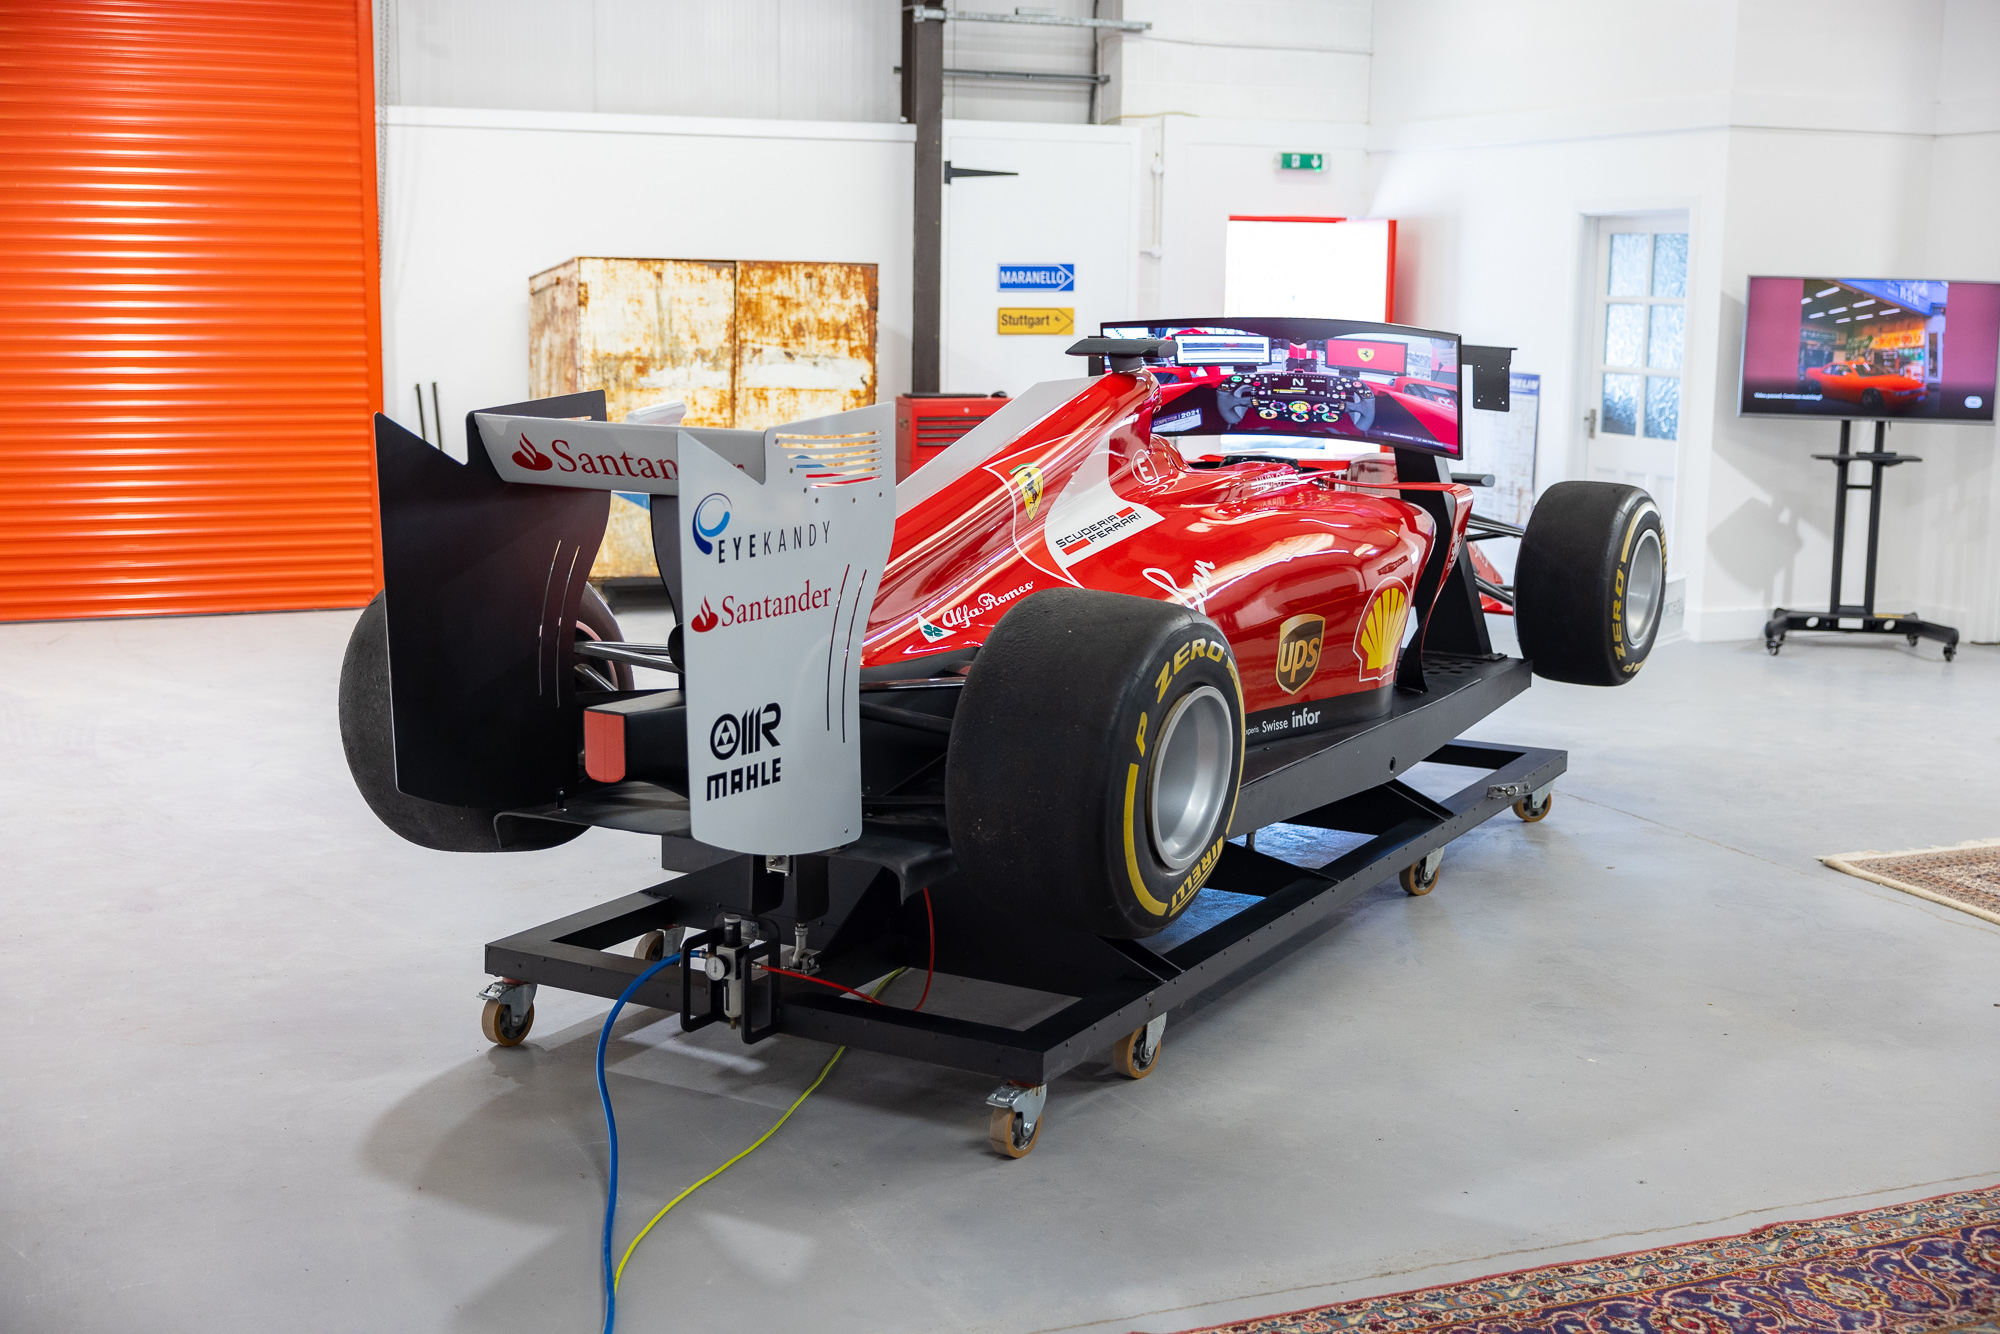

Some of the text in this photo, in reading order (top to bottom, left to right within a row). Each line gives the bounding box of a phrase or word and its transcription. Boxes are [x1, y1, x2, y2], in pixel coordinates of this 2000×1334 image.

[1001, 271, 1066, 284] MARANELLO
[1001, 314, 1050, 329] Stuttgart
[1181, 408, 1200, 419] 2021
[1137, 457, 1153, 482] E
[718, 521, 830, 564] EYEKANDY
[1055, 514, 1119, 548] SCUDERIA
[1088, 512, 1142, 543] FERRARI
[721, 579, 832, 627] Santander
[942, 581, 1034, 629] Alfa Romeo
[1612, 568, 1626, 661] ZERO
[1280, 638, 1320, 683] ups
[1136, 638, 1225, 757] P ZERO
[1262, 719, 1288, 733] Swisse
[1291, 707, 1321, 728] infor
[706, 757, 782, 802] MAHLE
